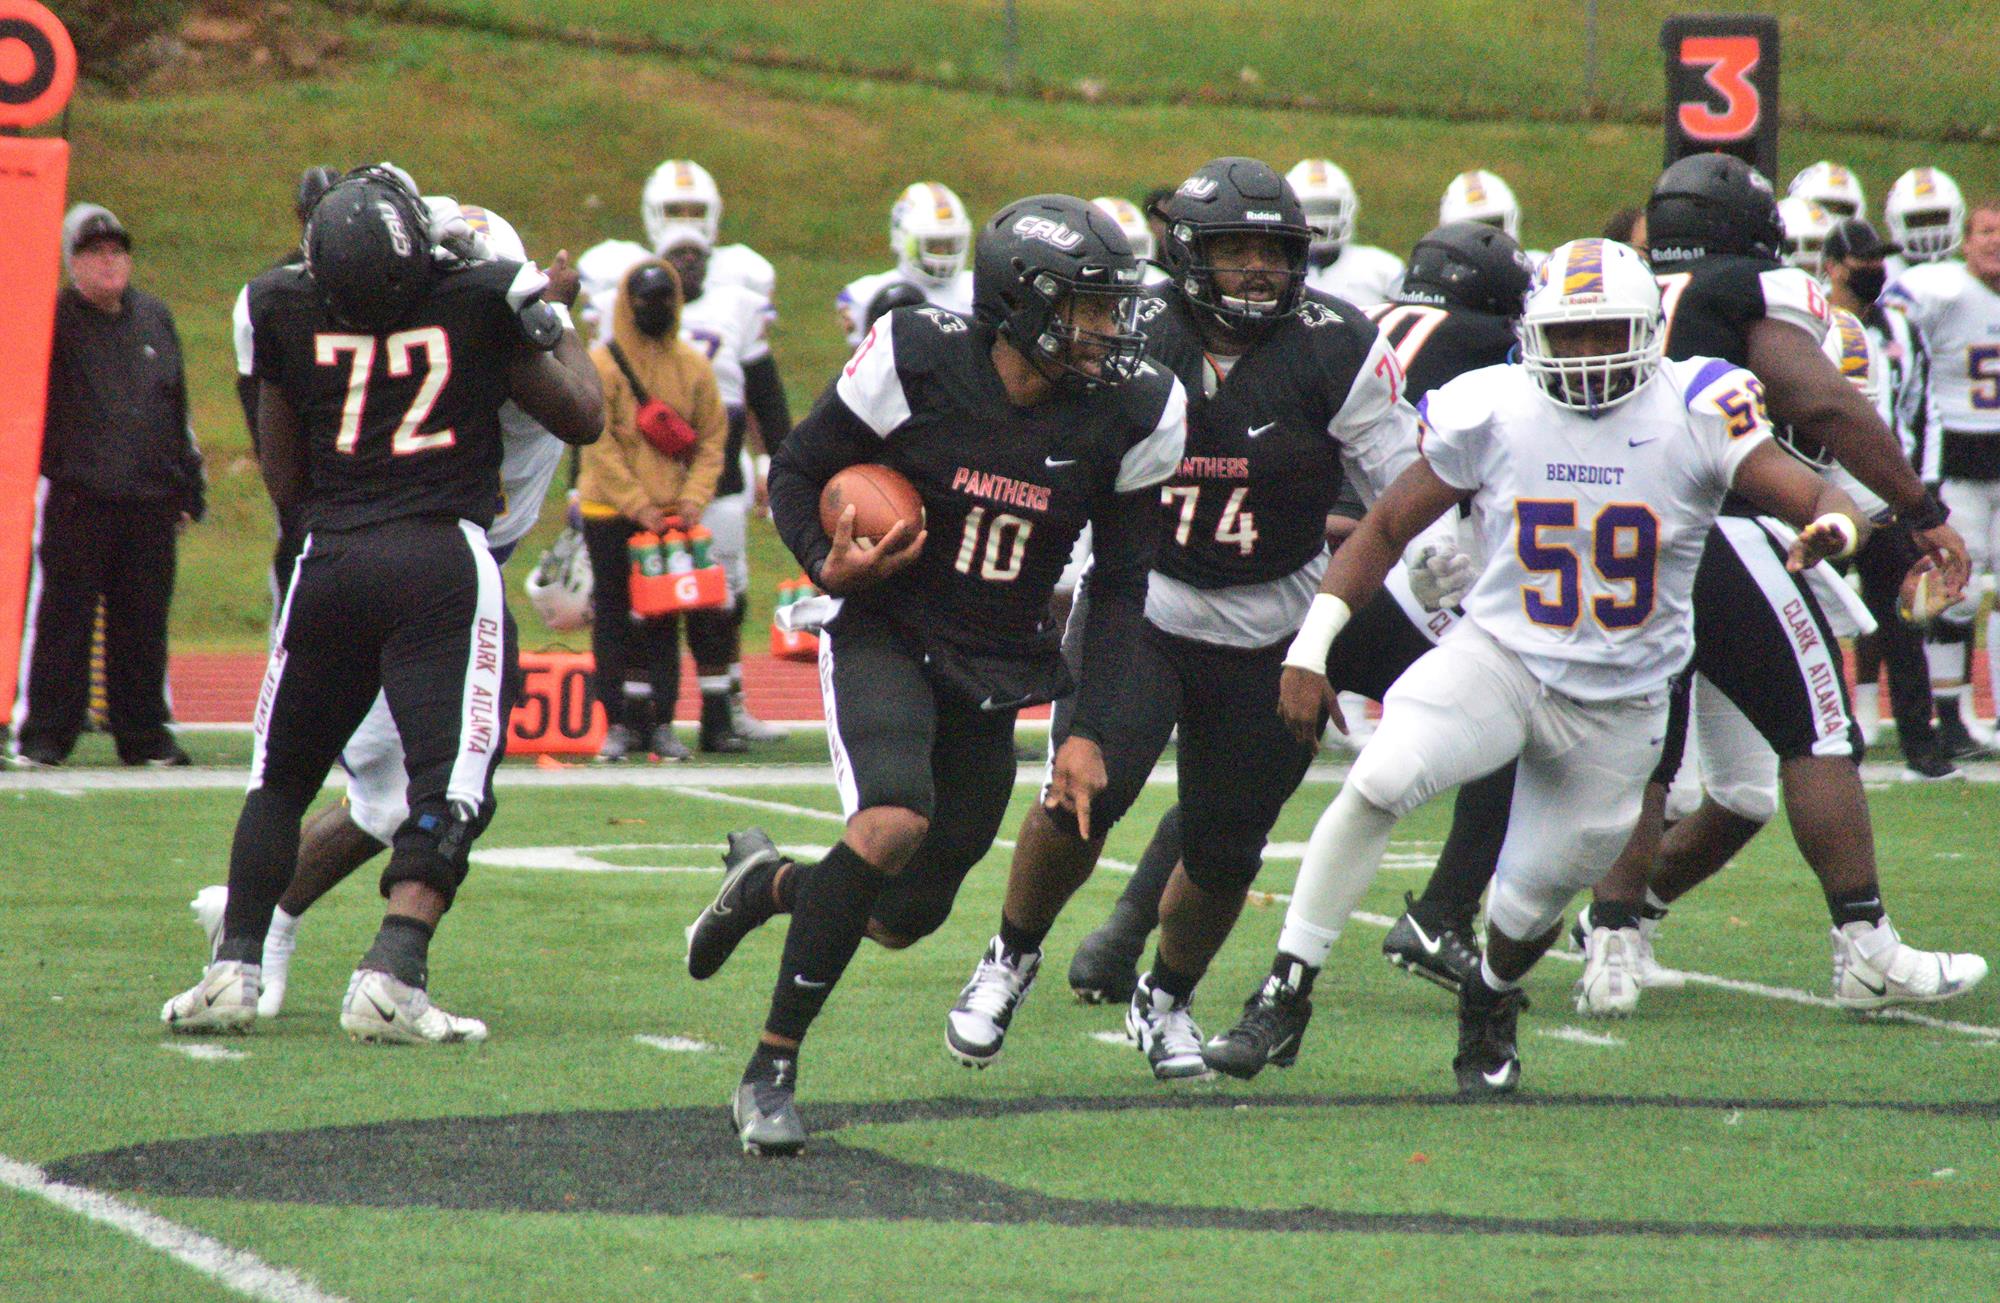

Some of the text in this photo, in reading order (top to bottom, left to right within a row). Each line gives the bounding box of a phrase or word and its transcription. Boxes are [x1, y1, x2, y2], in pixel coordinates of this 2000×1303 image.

[1679, 36, 1760, 141] 3
[1175, 177, 1219, 199] AU
[1246, 210, 1282, 221] Riddell
[1013, 215, 1084, 249] CAU
[314, 325, 456, 456] 72
[951, 466, 1052, 512] PANTHERS
[1176, 456, 1249, 479] ANTHERS
[1546, 463, 1625, 485] BENEDICT
[954, 506, 1034, 582] 10
[1160, 485, 1259, 555] 74
[1514, 497, 1661, 632] 59
[1427, 610, 1452, 638] CL
[467, 616, 498, 755] CLARK ATLANTA
[1783, 598, 1844, 735] CLARK ATLANTA
[513, 667, 593, 740] 50
